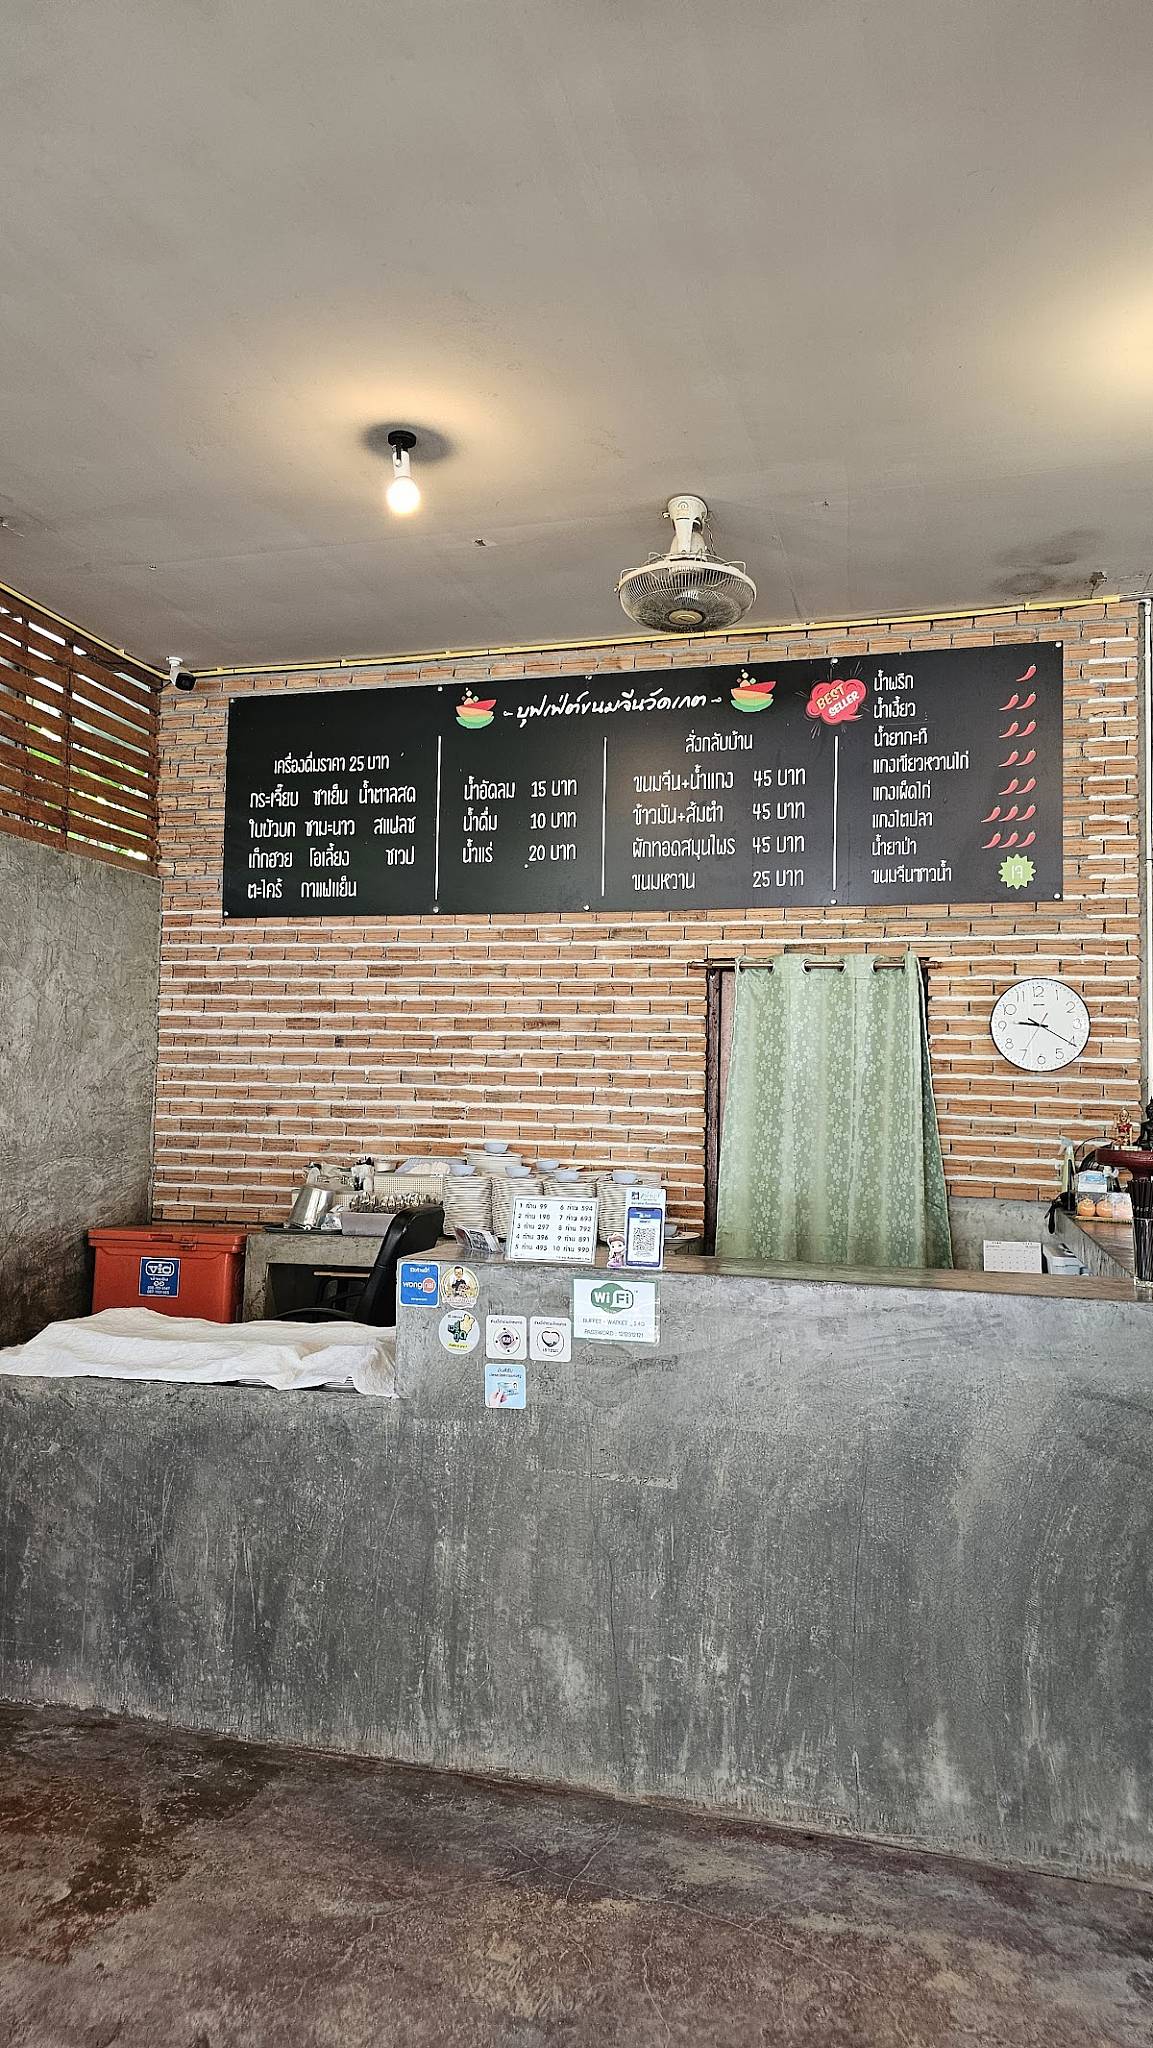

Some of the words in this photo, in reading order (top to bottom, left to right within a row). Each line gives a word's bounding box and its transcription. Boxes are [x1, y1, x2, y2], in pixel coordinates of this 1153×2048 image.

[874, 669, 913, 691] น้ำพริก
[816, 683, 845, 710] BEST
[828, 690, 860, 717] SELLER
[874, 696, 917, 719] น้ำเงี้ยว
[686, 730, 752, 752] สั่งกลับบ้าน
[874, 724, 927, 747] น้ำยากะทิ
[274, 751, 345, 774] เครื่องดื่มราคา
[349, 756, 365, 772] 25
[368, 755, 389, 770] บาท
[873, 750, 969, 773] แกงเขียวหวานไก่
[464, 776, 515, 800] น้ำอัดลม
[531, 781, 546, 797] 15
[552, 779, 577, 796] บาท
[633, 764, 733, 792] ขนมจีน+น้ำแกง
[754, 770, 771, 787] 45
[778, 768, 805, 786] บาท
[250, 784, 298, 808] กระเจี๊ยบ
[313, 783, 348, 805] ชาเย็น
[359, 780, 416, 804] น้ำตาลสด
[873, 780, 930, 800] แกงเผ็ดไก่
[464, 806, 497, 831] น้ำดื่ม
[530, 813, 546, 829] 10
[551, 812, 576, 828] บาท
[633, 800, 723, 825] ข้าวมัน+ส้มตำ
[753, 803, 770, 820] 45
[777, 802, 804, 819] บาท
[872, 810, 932, 828] แกงไตปลา
[249, 818, 295, 838] ใบบัวบก
[305, 820, 355, 837] ชามะนาว
[249, 847, 292, 868] เก็กฮวย
[310, 843, 349, 867] โอเลี้ยง
[463, 838, 493, 863] น้ำแร่
[528, 845, 545, 861] 20
[551, 844, 575, 860] บาท
[633, 834, 735, 860] ผักทอดสมุนไพร
[753, 835, 772, 853] 45
[777, 836, 804, 852] บาท
[872, 834, 916, 855] น้ำยาป่า
[632, 873, 695, 890] ขนมหวาน
[753, 871, 770, 887] 25
[776, 870, 803, 886] บาท
[871, 860, 951, 883] ขนมจีนซาวน้ำ
[1010, 864, 1024, 880] เจ
[248, 878, 283, 899] ตะไคร้
[301, 875, 356, 898] กาแฟเย็น
[1016, 990, 1025, 1003] 11
[1032, 985, 1045, 998] 12
[1002, 1003, 1018, 1016] 10
[1065, 1000, 1076, 1014] 2
[997, 1020, 1008, 1032] 9
[1072, 1017, 1083, 1030] 3
[1004, 1037, 1015, 1050] 8
[1019, 1048, 1028, 1061] 7
[1055, 1047, 1065, 1060] 5
[537, 1223, 550, 1231] 297
